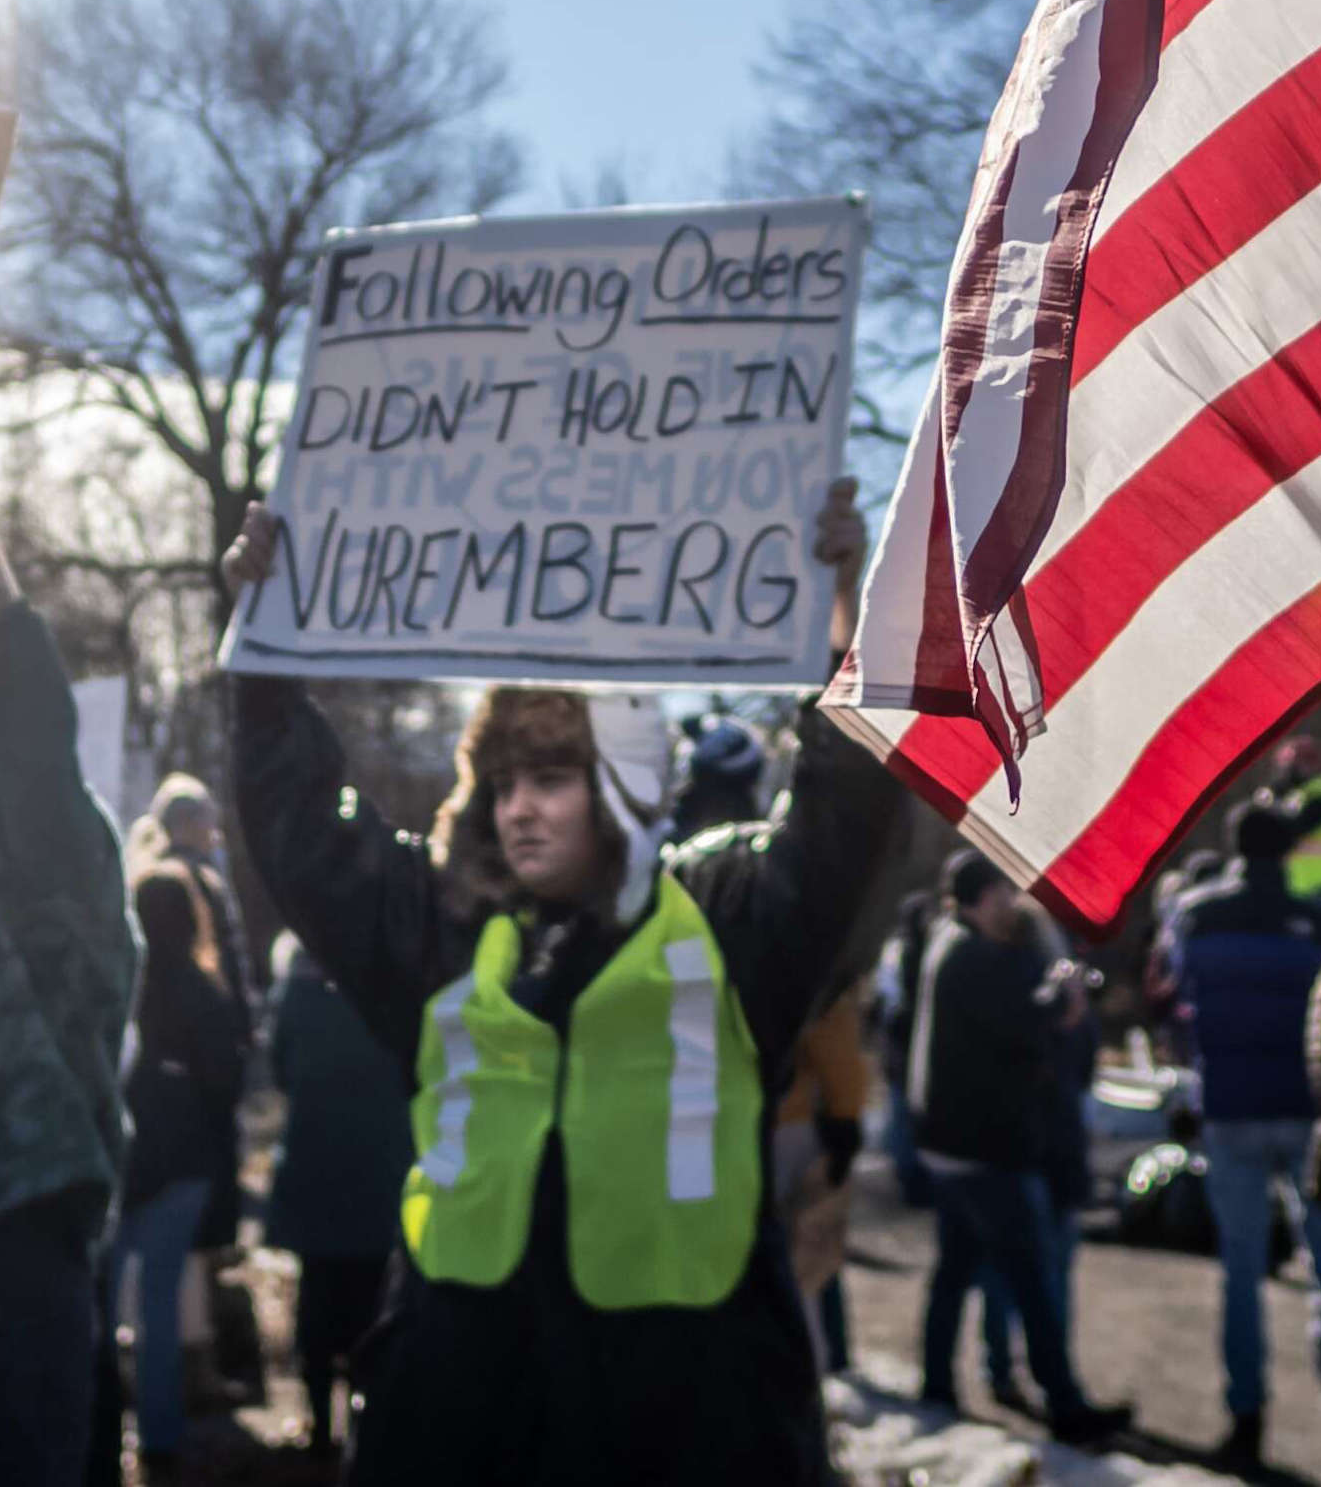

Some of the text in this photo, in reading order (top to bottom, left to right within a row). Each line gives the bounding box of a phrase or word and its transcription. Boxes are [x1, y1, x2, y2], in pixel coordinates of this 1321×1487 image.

[320, 214, 846, 352] Following Orders
[298, 351, 838, 451] DIDN'T HOLD IN
[245, 507, 799, 636] NUREMBERG
